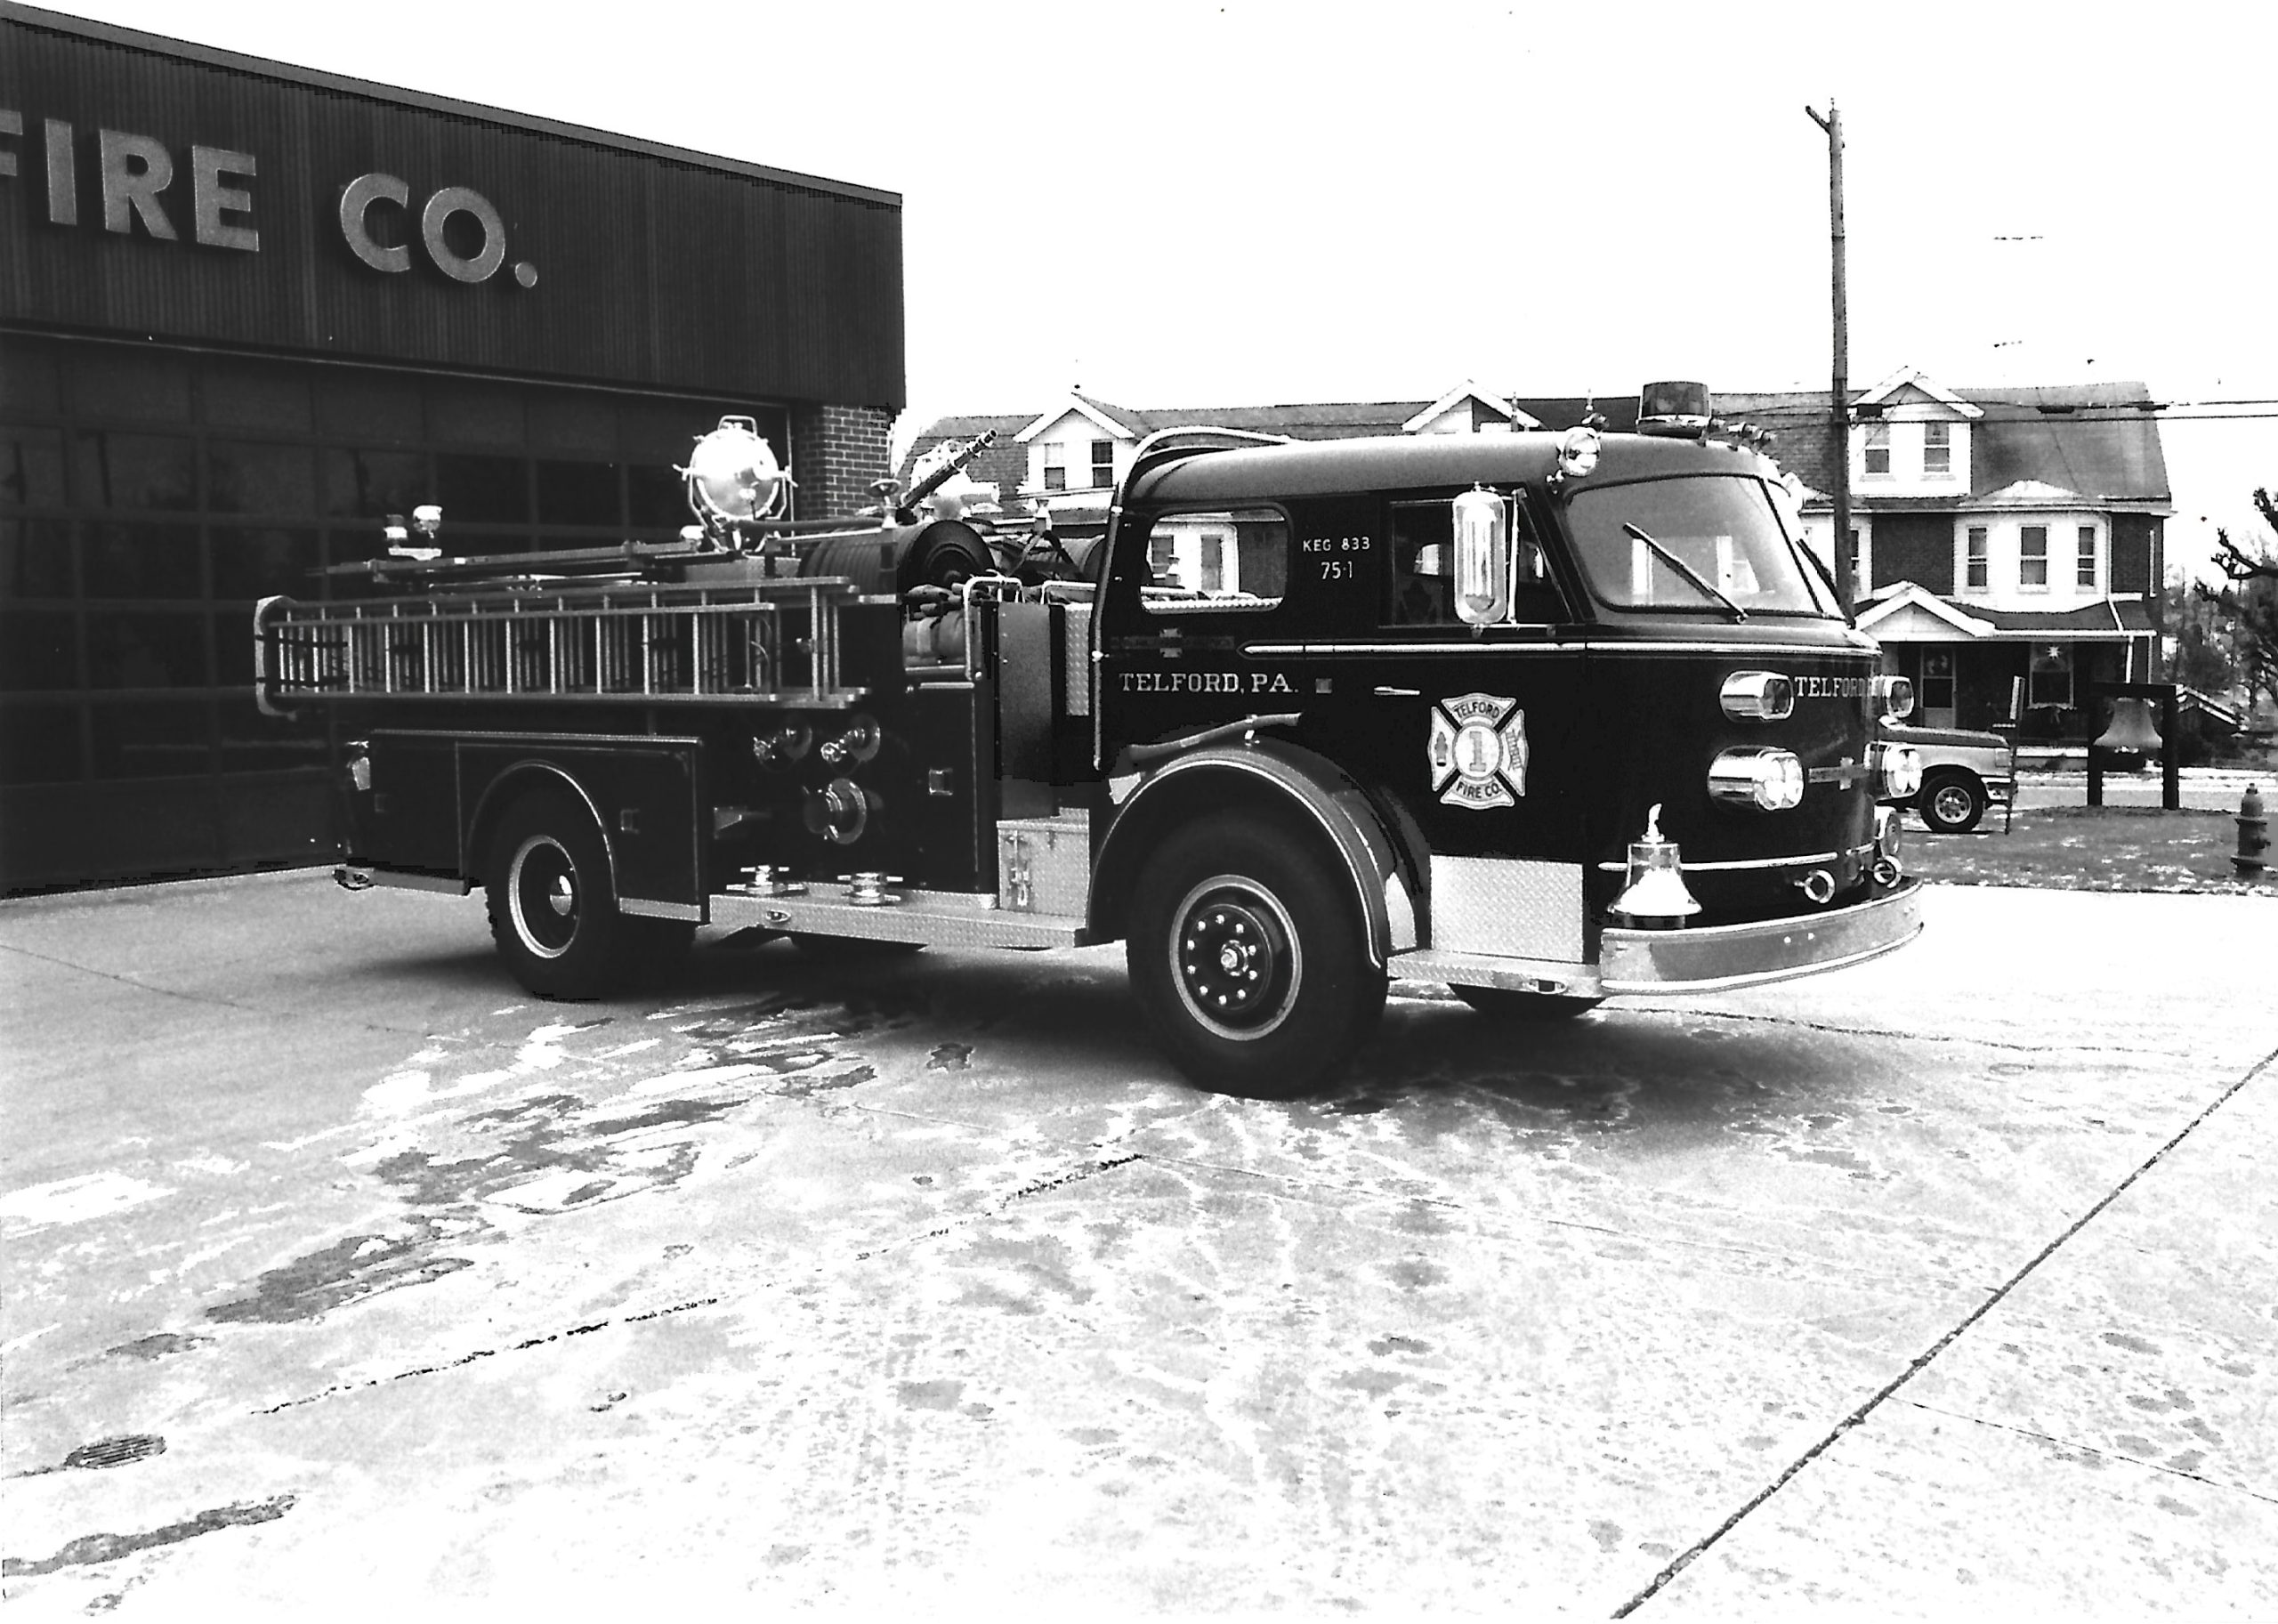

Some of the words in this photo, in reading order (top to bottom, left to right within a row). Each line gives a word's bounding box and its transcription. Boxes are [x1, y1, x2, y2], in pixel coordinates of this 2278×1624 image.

[340, 173, 537, 288] CO.
[1303, 538, 1331, 552] KEG
[1341, 536, 1370, 551] 833
[1119, 673, 1244, 695] TELFORD,
[1251, 673, 1299, 693] PA.
[1454, 701, 1500, 719] TELFORD
[1456, 781, 1482, 799] FIRE
